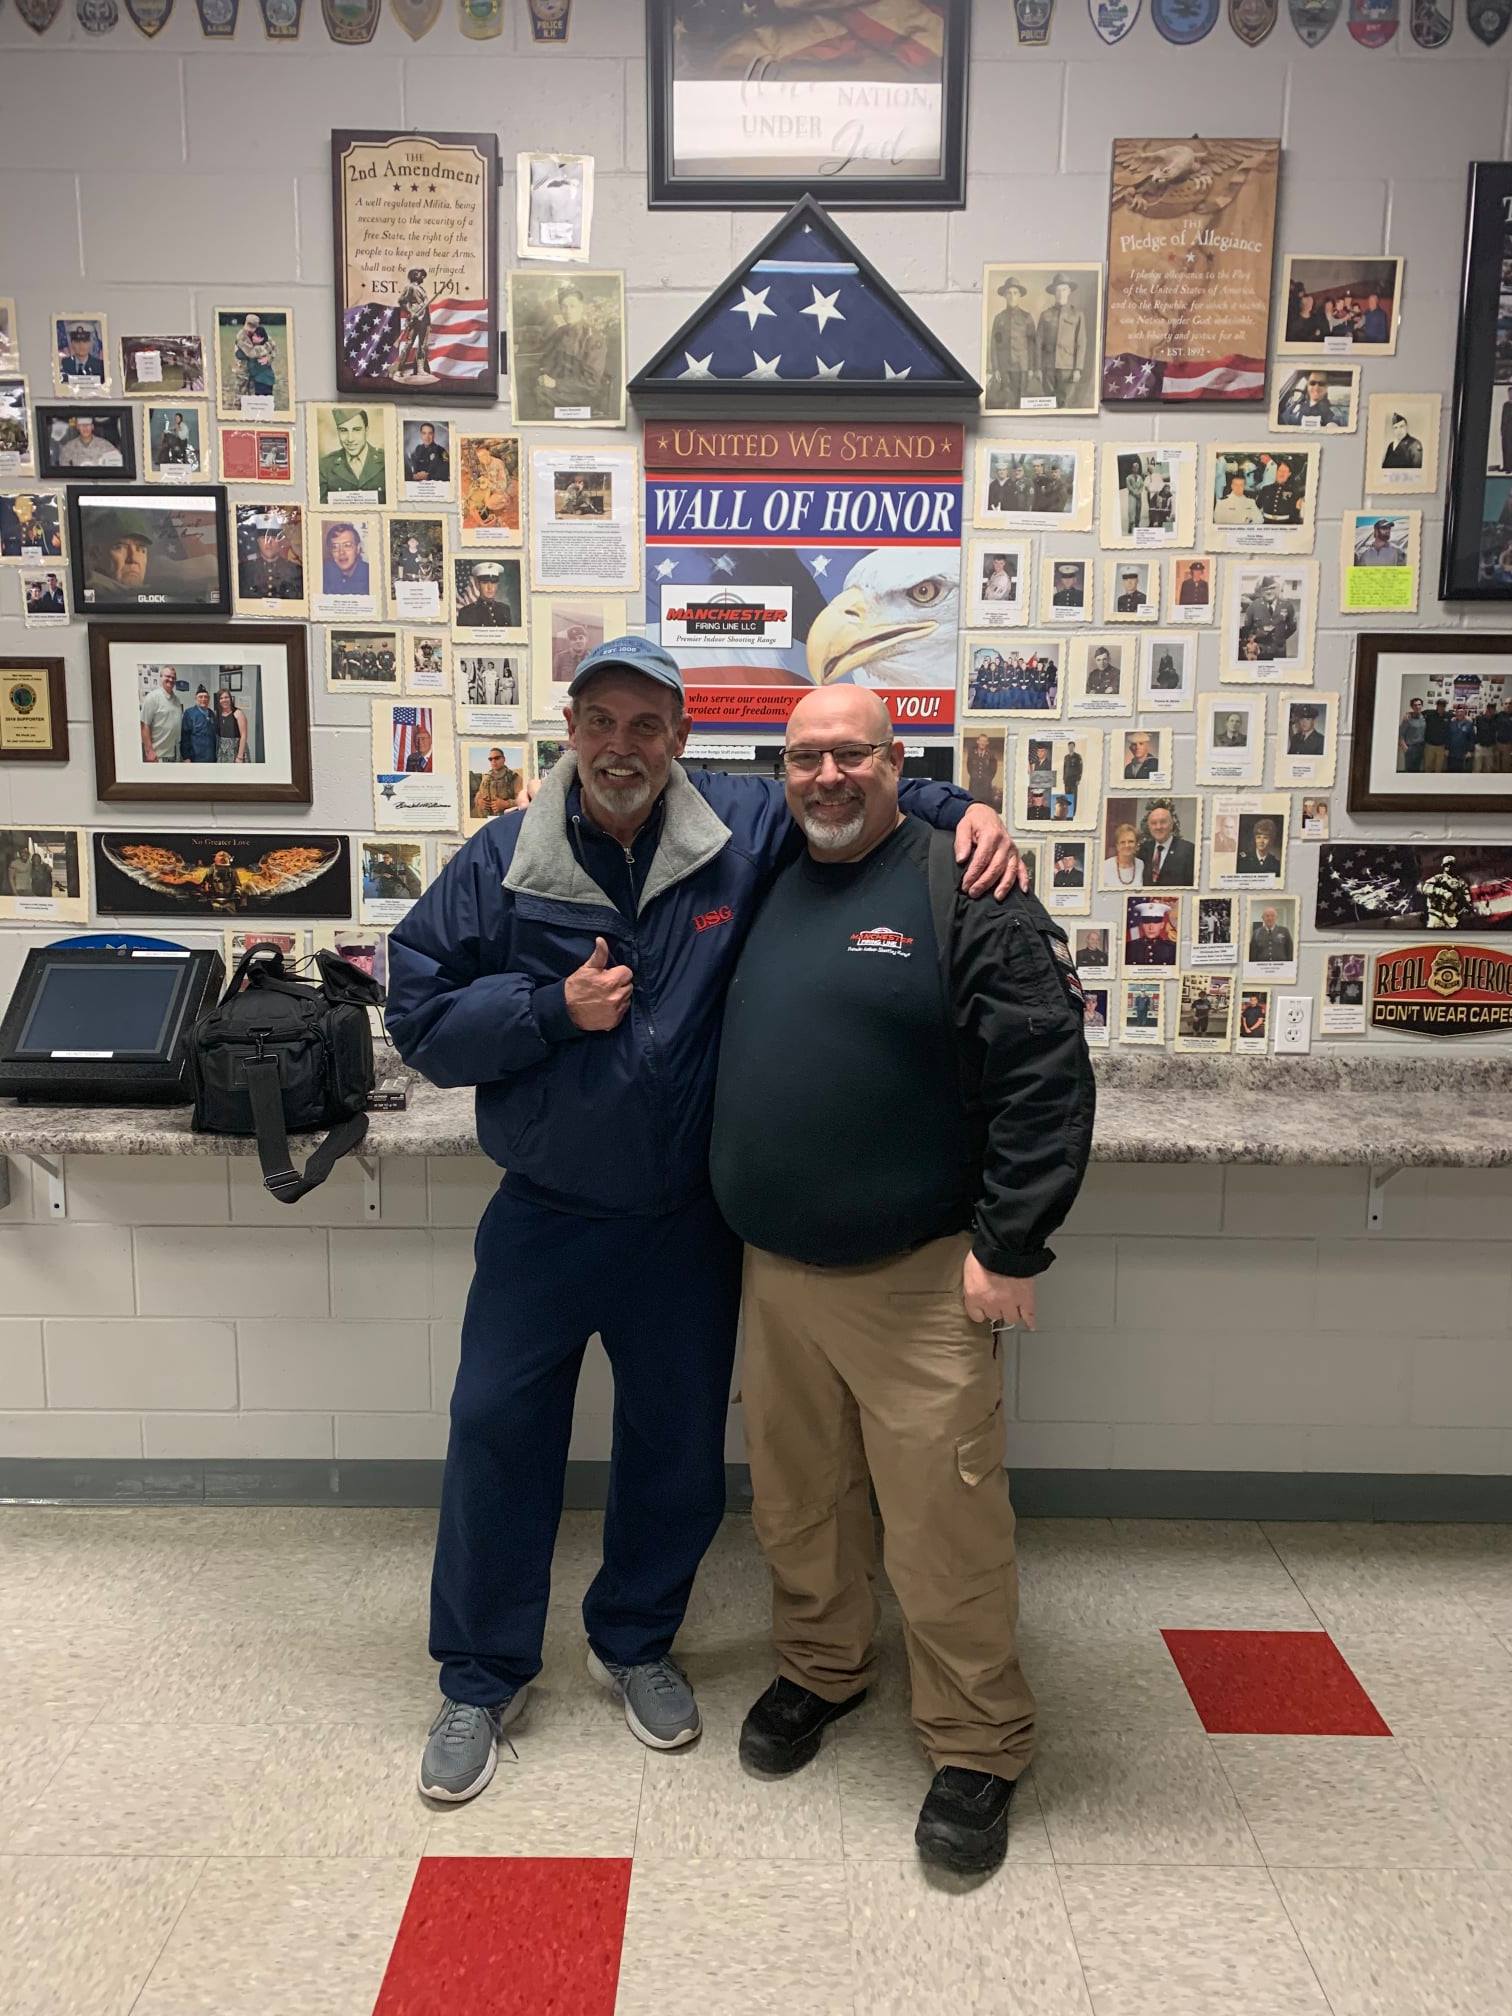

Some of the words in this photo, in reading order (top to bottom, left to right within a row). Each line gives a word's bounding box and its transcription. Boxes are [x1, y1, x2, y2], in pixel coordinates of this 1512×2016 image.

[838, 87, 934, 111] NATION,
[741, 114, 823, 139] UNDER
[405, 153, 425, 162] THE
[348, 162, 377, 182] 2nd
[384, 160, 480, 185] Amendment
[355, 198, 363, 207] A
[365, 198, 381, 207] well
[384, 198, 421, 209] regulated
[455, 200, 476, 211] being
[358, 216, 395, 226] necessary
[398, 216, 407, 225] to
[409, 216, 421, 225] the
[424, 216, 455, 227] security
[457, 216, 467, 228] of
[363, 229, 379, 242] free
[408, 231, 420, 241] the
[422, 231, 441, 243] right
[444, 232, 455, 244] of
[456, 232, 468, 242] the
[1120, 232, 1167, 253] Pledge
[1170, 229, 1187, 246] of
[1191, 229, 1264, 252] Allegiance
[355, 247, 382, 258] people
[385, 248, 394, 256] to
[396, 247, 414, 259] keep
[416, 248, 430, 257] and
[433, 249, 450, 258] bear
[361, 263, 379, 272] shall
[381, 264, 395, 273] not
[398, 264, 406, 273] be
[1135, 269, 1162, 282] pledge
[1206, 270, 1215, 280] to
[371, 281, 401, 294] EST.
[433, 281, 460, 295] 1791
[1122, 286, 1133, 297] of
[1135, 285, 1148, 295] the
[1150, 284, 1178, 295] United
[1179, 284, 1206, 295] States
[1207, 286, 1218, 297] of
[1128, 302, 1137, 310] to
[1139, 301, 1152, 309] the
[1190, 302, 1205, 312] for
[1167, 316, 1190, 326] under
[1174, 331, 1190, 340] and
[1219, 330, 1232, 342] for
[672, 429, 779, 457] UNITED
[787, 427, 832, 459] WE
[840, 430, 936, 461] STAND
[654, 488, 753, 531] WALL
[763, 489, 815, 531] OF
[820, 490, 956, 533] HONOR
[138, 595, 166, 603] GLOCK
[666, 608, 788, 622] MANCHESTER
[695, 622, 720, 630] FIRING
[722, 622, 739, 631] LINE
[741, 622, 757, 631] LLC
[676, 635, 701, 643] Premier
[704, 635, 726, 643] Indoor
[727, 636, 755, 644] Shooting
[757, 637, 776, 645] Range
[688, 693, 708, 703] who
[711, 696, 736, 704] serve
[737, 696, 754, 704] our
[757, 695, 793, 706] country
[687, 705, 721, 715] protect
[723, 706, 740, 715] our
[741, 705, 789, 717] freedoms.
[896, 696, 941, 717] YOU!
[204, 838, 231, 846] Greater
[233, 838, 250, 846] Love
[693, 905, 733, 931] DSG
[850, 933, 913, 944] MANCHESTER
[1377, 957, 1427, 996] REAL
[1375, 1005, 1420, 1021] DON'T
[1423, 1007, 1467, 1022] WEAR
